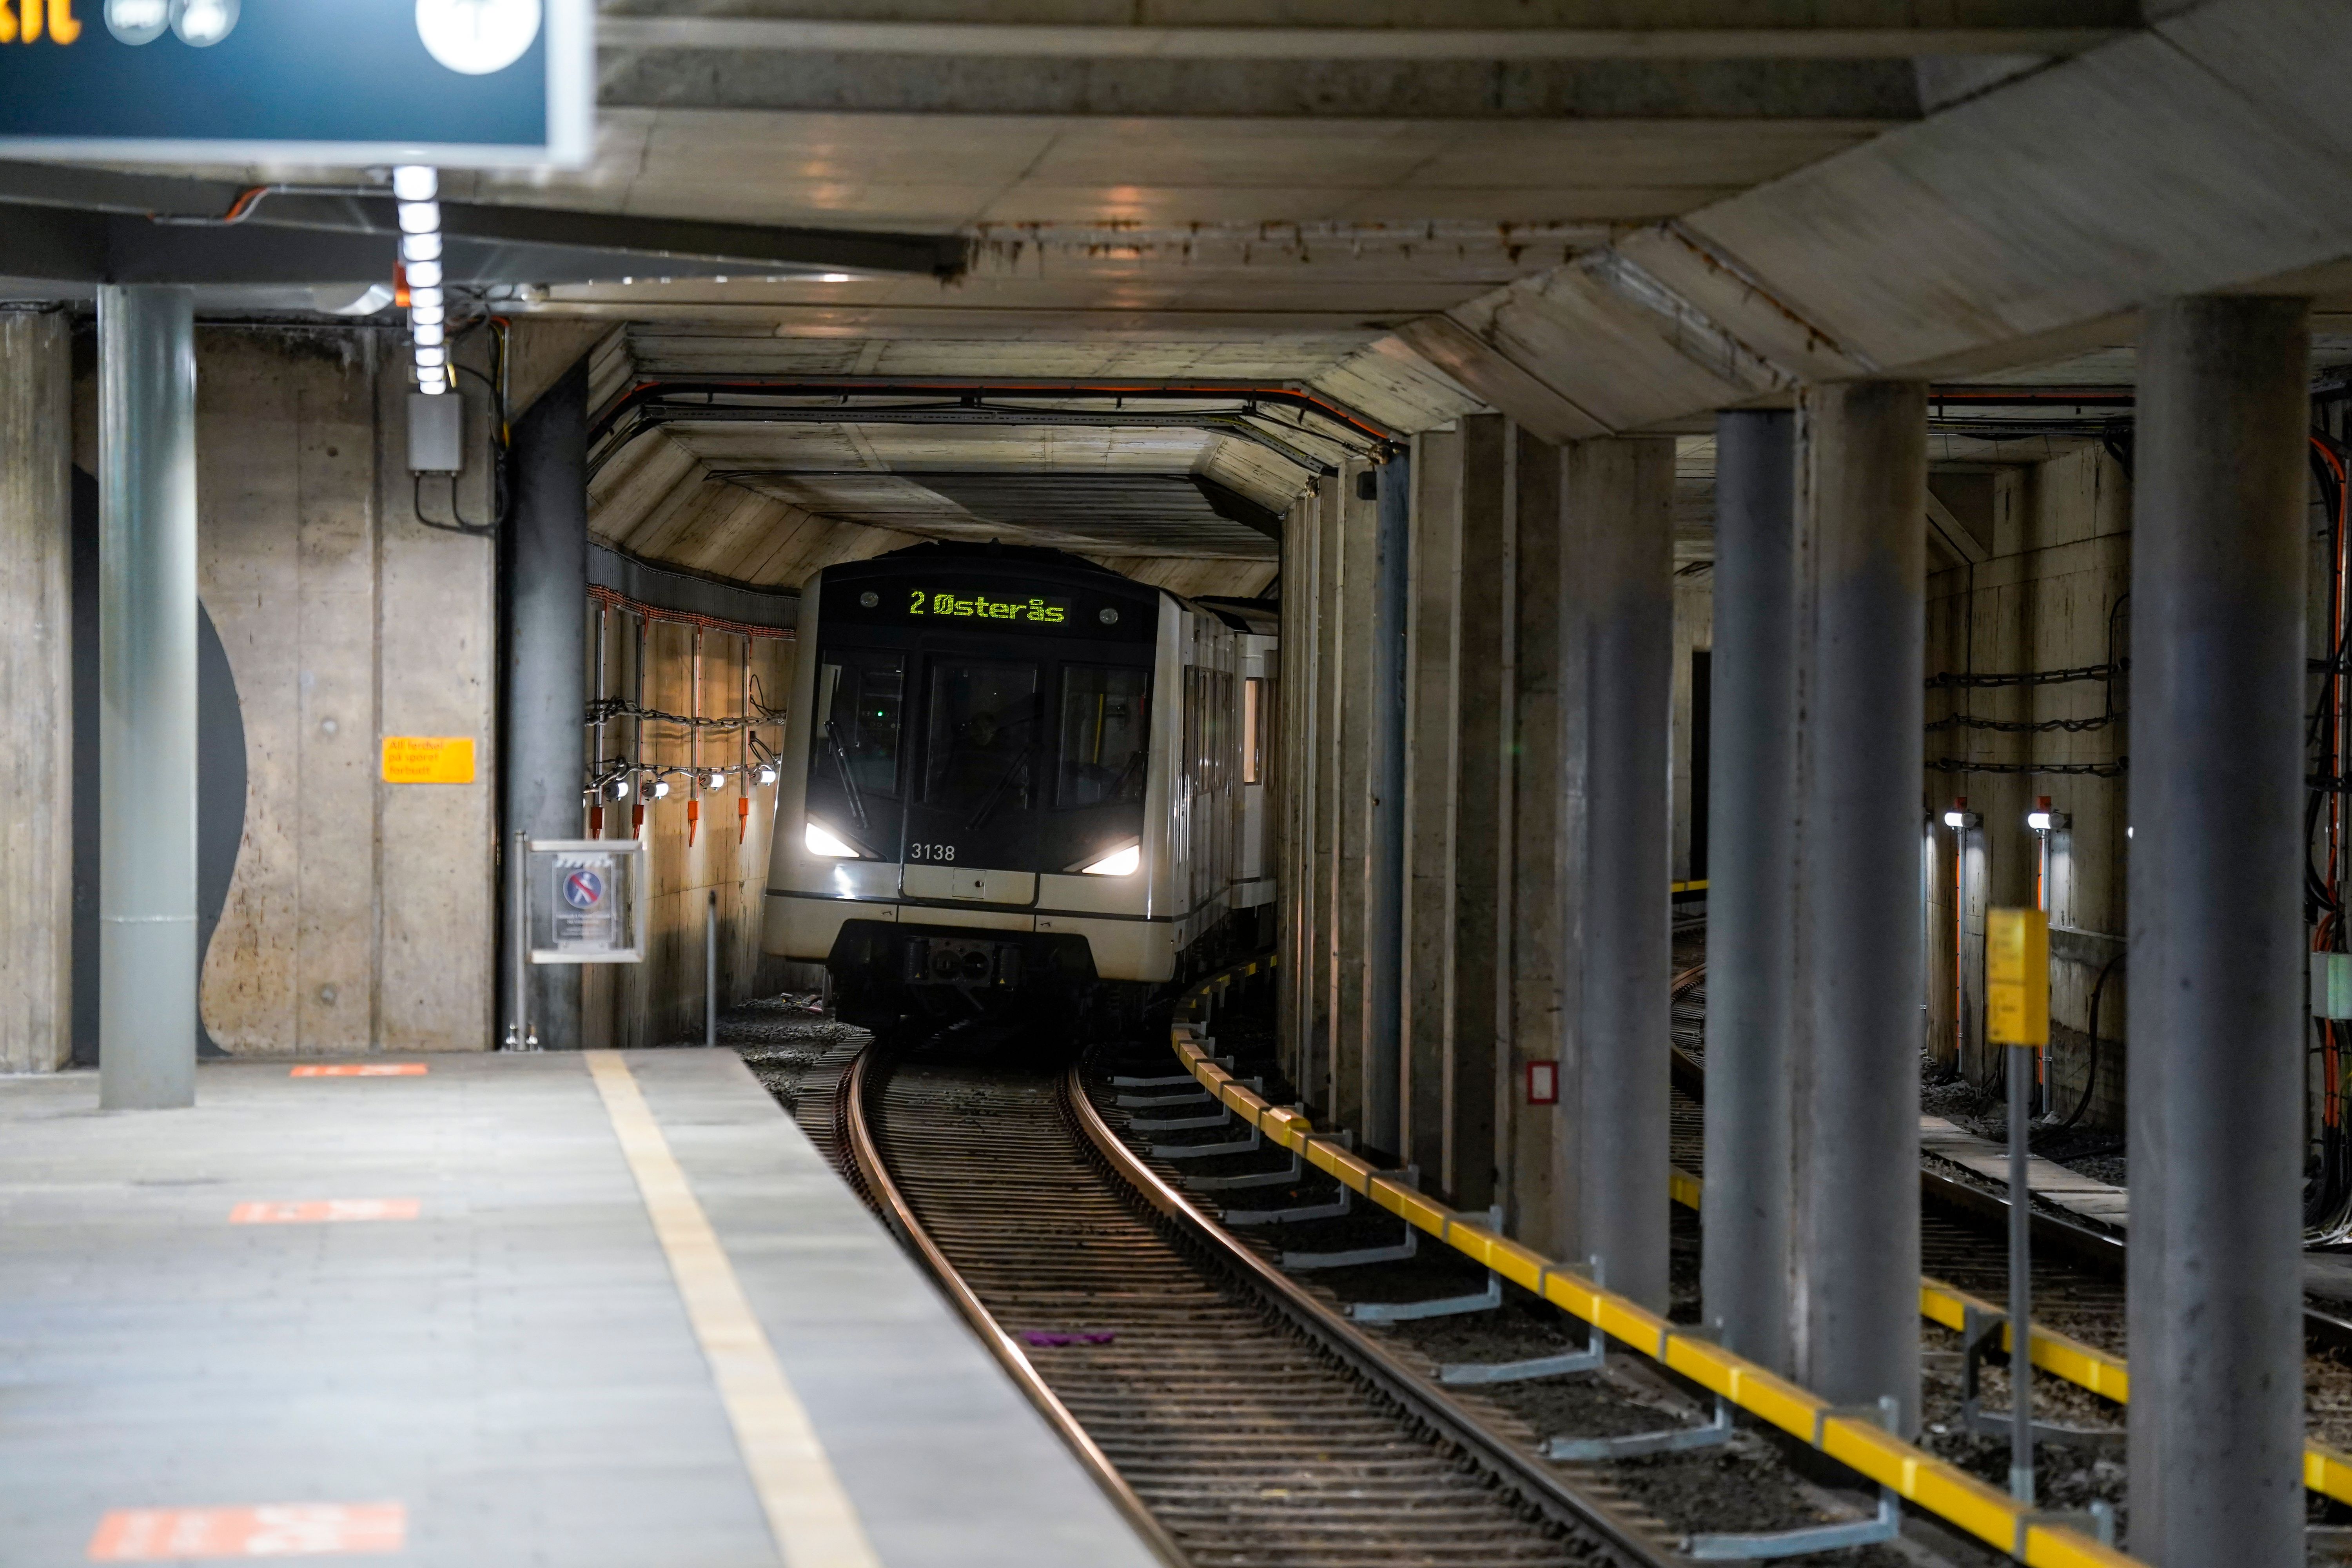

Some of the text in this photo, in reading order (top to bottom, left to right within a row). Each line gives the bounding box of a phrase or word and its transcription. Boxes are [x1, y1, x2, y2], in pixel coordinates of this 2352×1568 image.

[910, 591, 1064, 622] 2 Østerås
[911, 843, 955, 861] 3138
